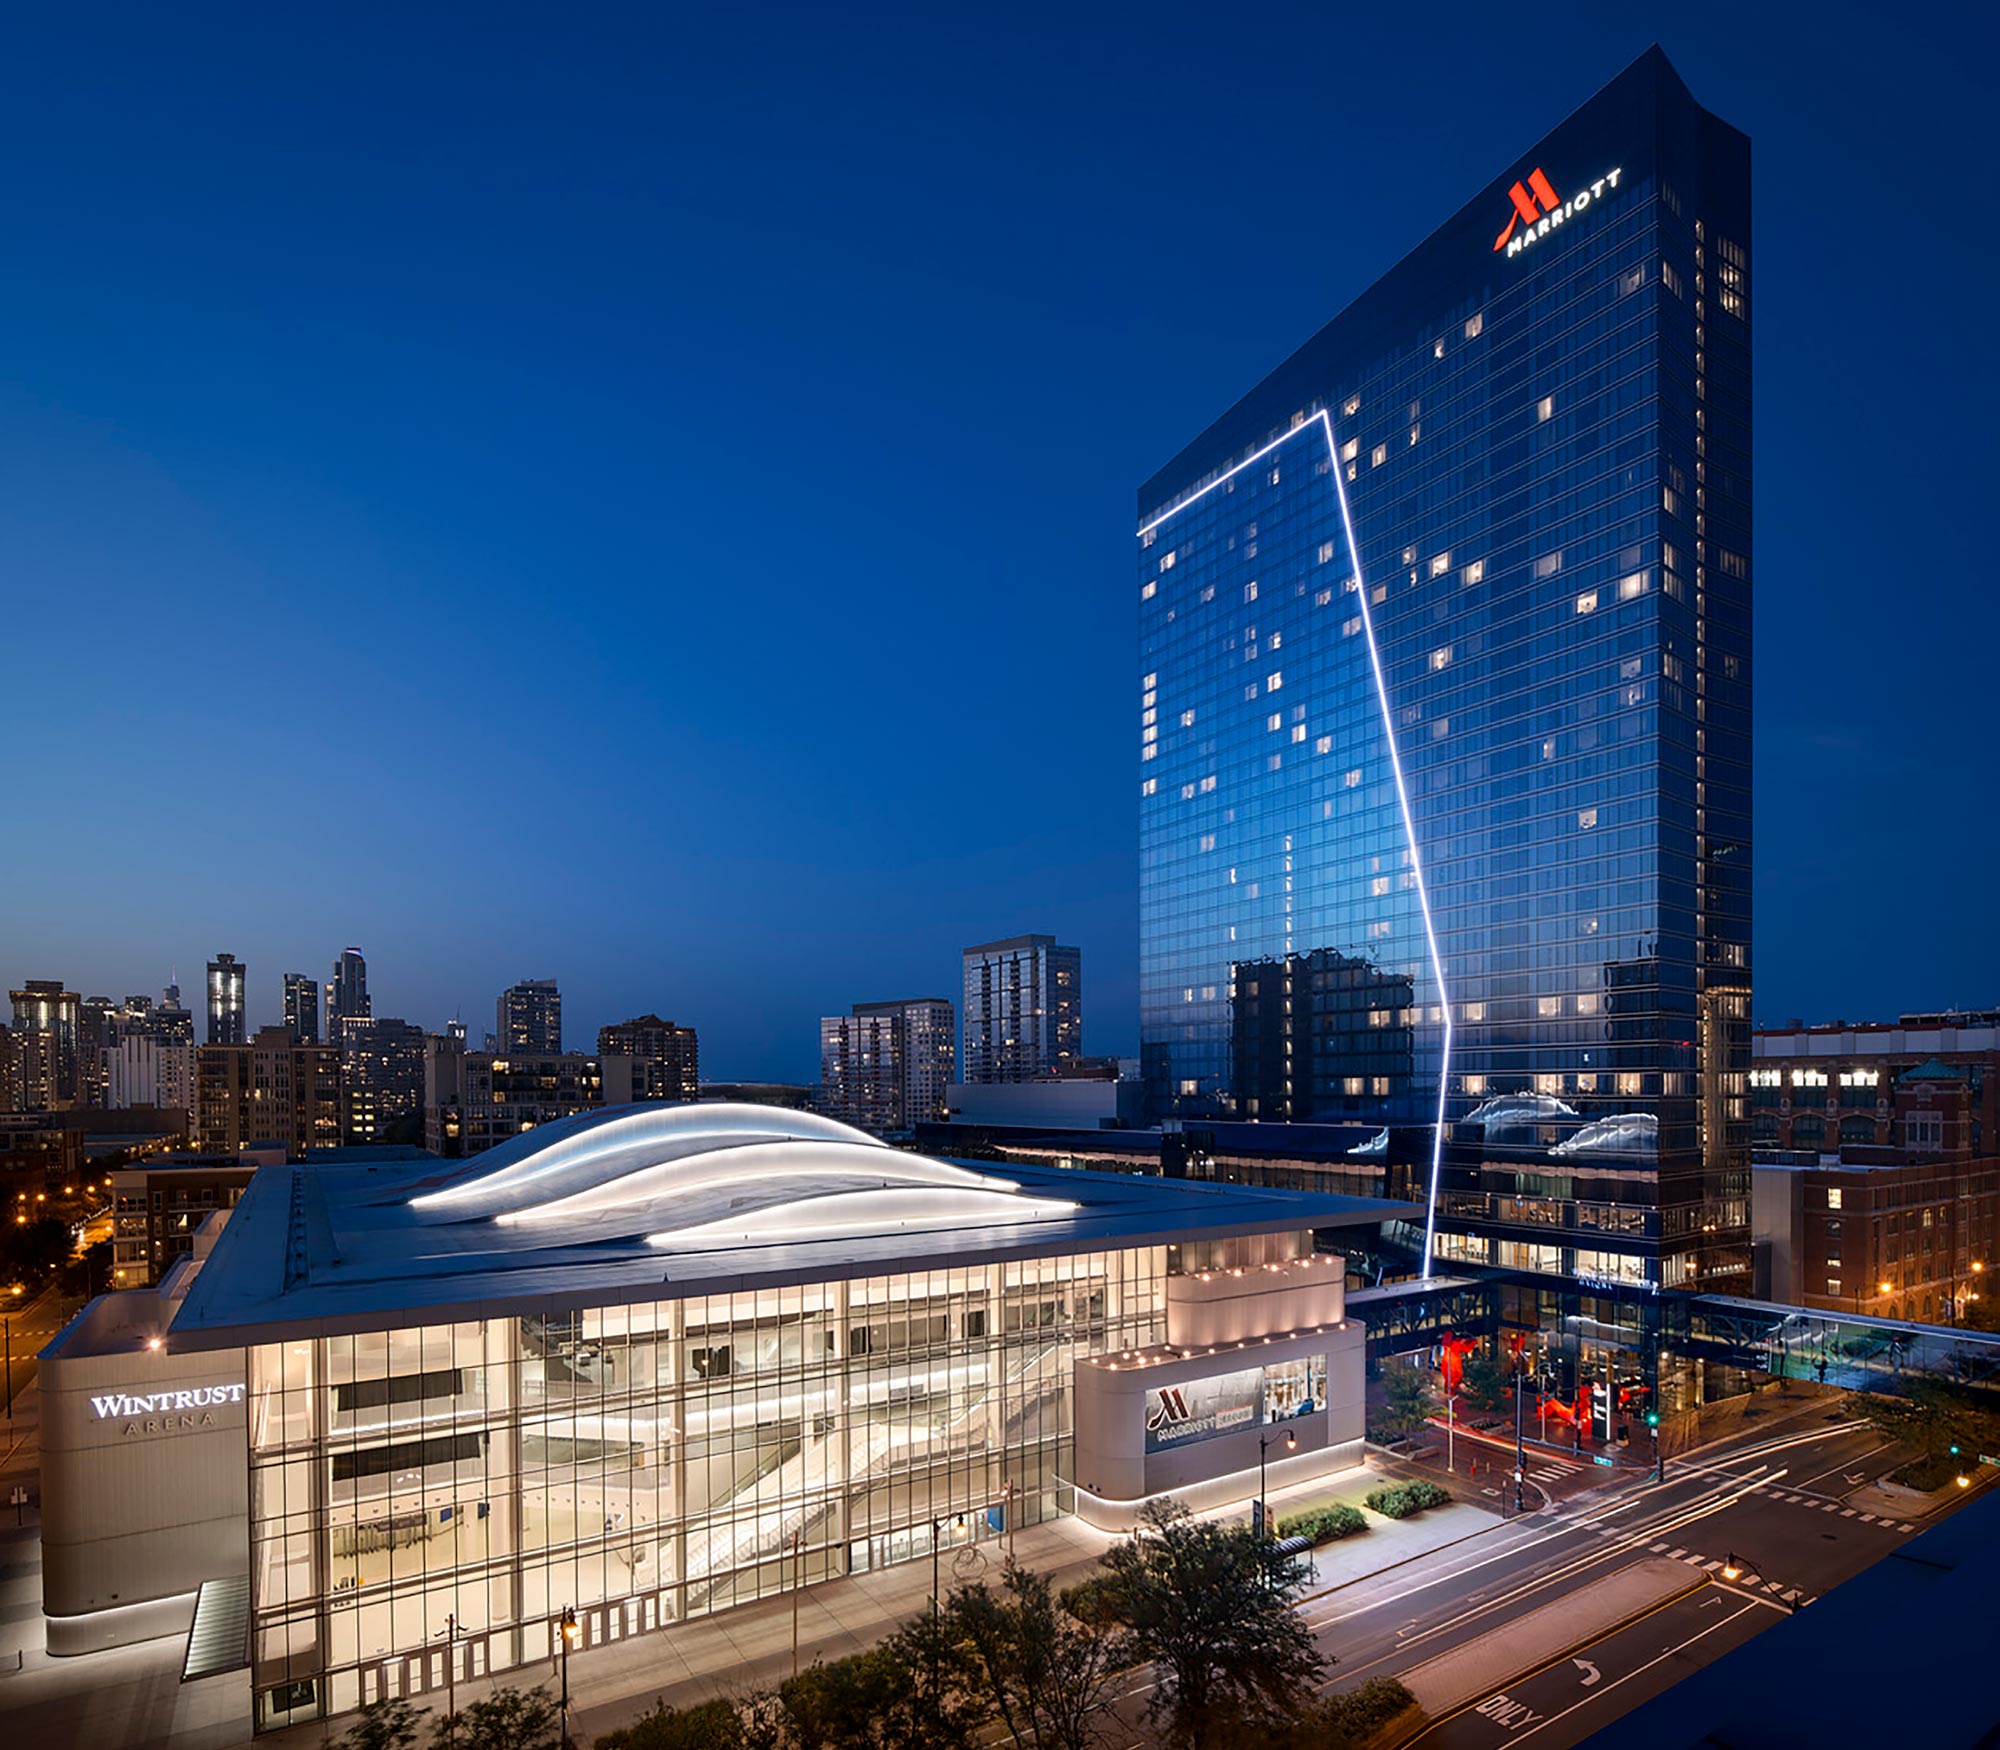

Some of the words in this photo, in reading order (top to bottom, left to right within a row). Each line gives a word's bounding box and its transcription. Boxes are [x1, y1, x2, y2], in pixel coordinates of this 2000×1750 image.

[1507, 167, 1621, 258] MARRIOTT
[91, 1384, 245, 1419] WINTRUST
[124, 1412, 216, 1436] ARENA
[1475, 1695, 1543, 1730] ONLY
